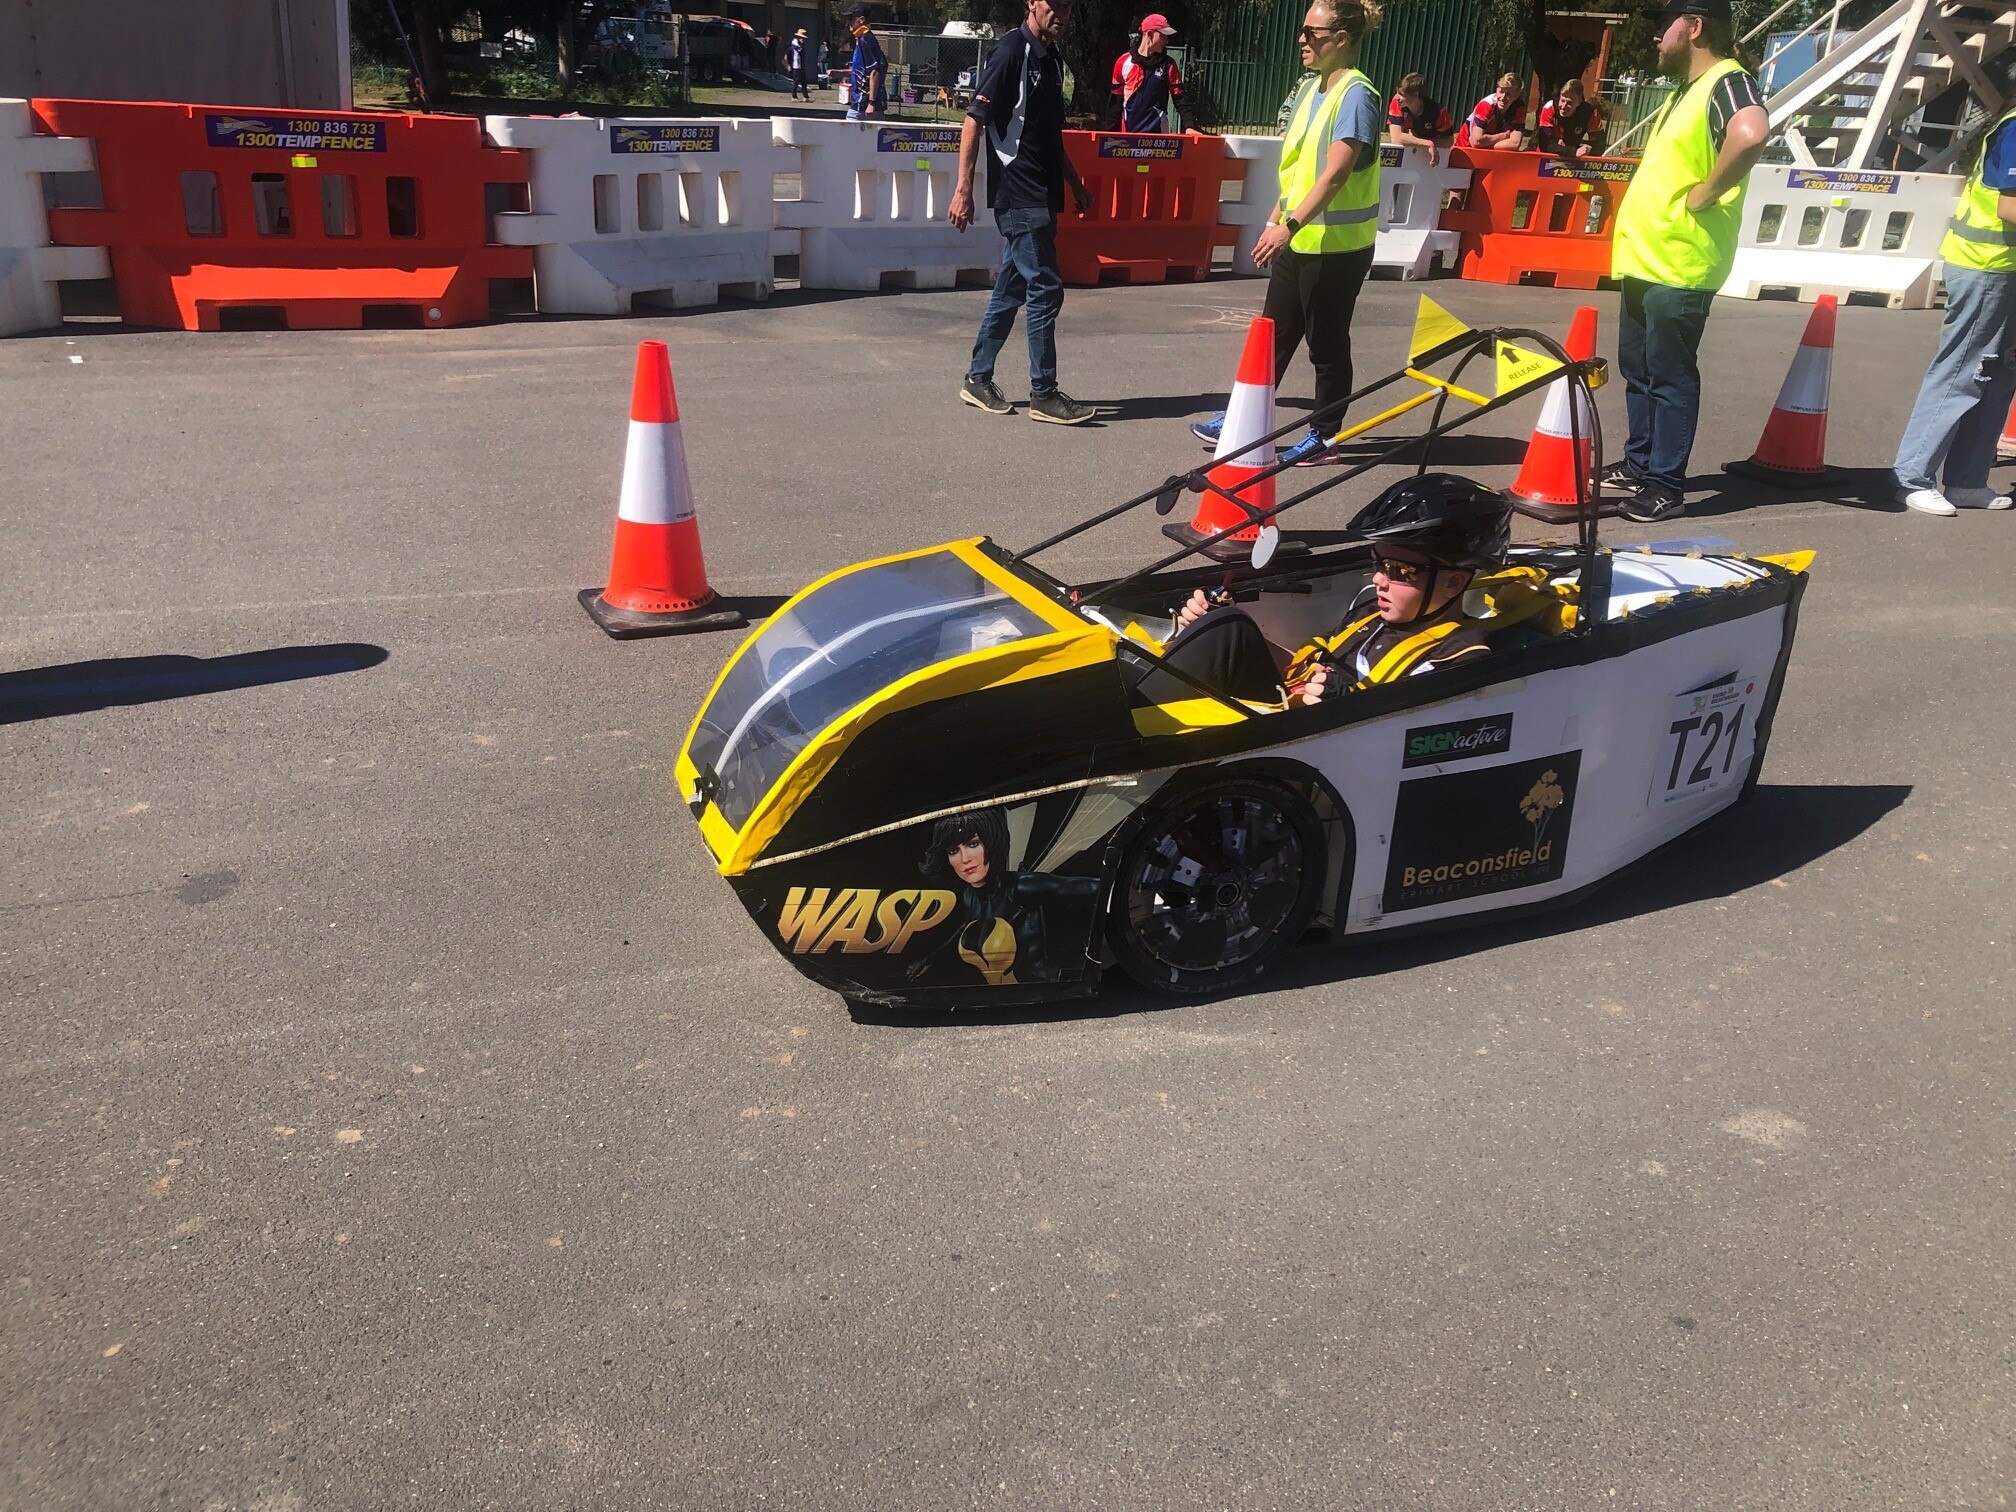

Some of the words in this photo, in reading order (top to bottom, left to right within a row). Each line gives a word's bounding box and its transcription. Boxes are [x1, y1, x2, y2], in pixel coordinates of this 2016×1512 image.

[287, 120, 320, 133] 1300
[323, 121, 348, 134] 836
[352, 122, 376, 135] 733
[660, 128, 680, 138] 1300
[682, 128, 697, 138] 836
[699, 128, 715, 138] 733
[236, 132, 375, 150] 1300TEMPFENCE
[920, 131, 937, 141] 1300
[938, 131, 952, 141] 836
[954, 132, 962, 140] 73
[628, 140, 713, 152] 1300TEMPFENCE
[892, 141, 961, 152] 1300TEMPFENC
[1137, 138, 1153, 147] 1300
[1153, 139, 1166, 148] 836
[1167, 140, 1180, 148] 733
[1111, 147, 1177, 158] 1300TEMPFENCE
[1583, 161, 1602, 170] 1300
[1602, 162, 1617, 170] 836
[1619, 164, 1634, 172] 733
[1553, 168, 1630, 181] 1300TEMPFENCE
[1837, 173, 1859, 182] 1300
[1859, 174, 1877, 183] 836
[1878, 175, 1894, 184] 733
[1803, 180, 1891, 193] 1300TEMPFENCE
[1508, 362, 1542, 381] RELEASE
[1667, 703, 1746, 790] T21
[1402, 840, 1552, 888] Beaconsfield
[777, 886, 957, 954] WASP
